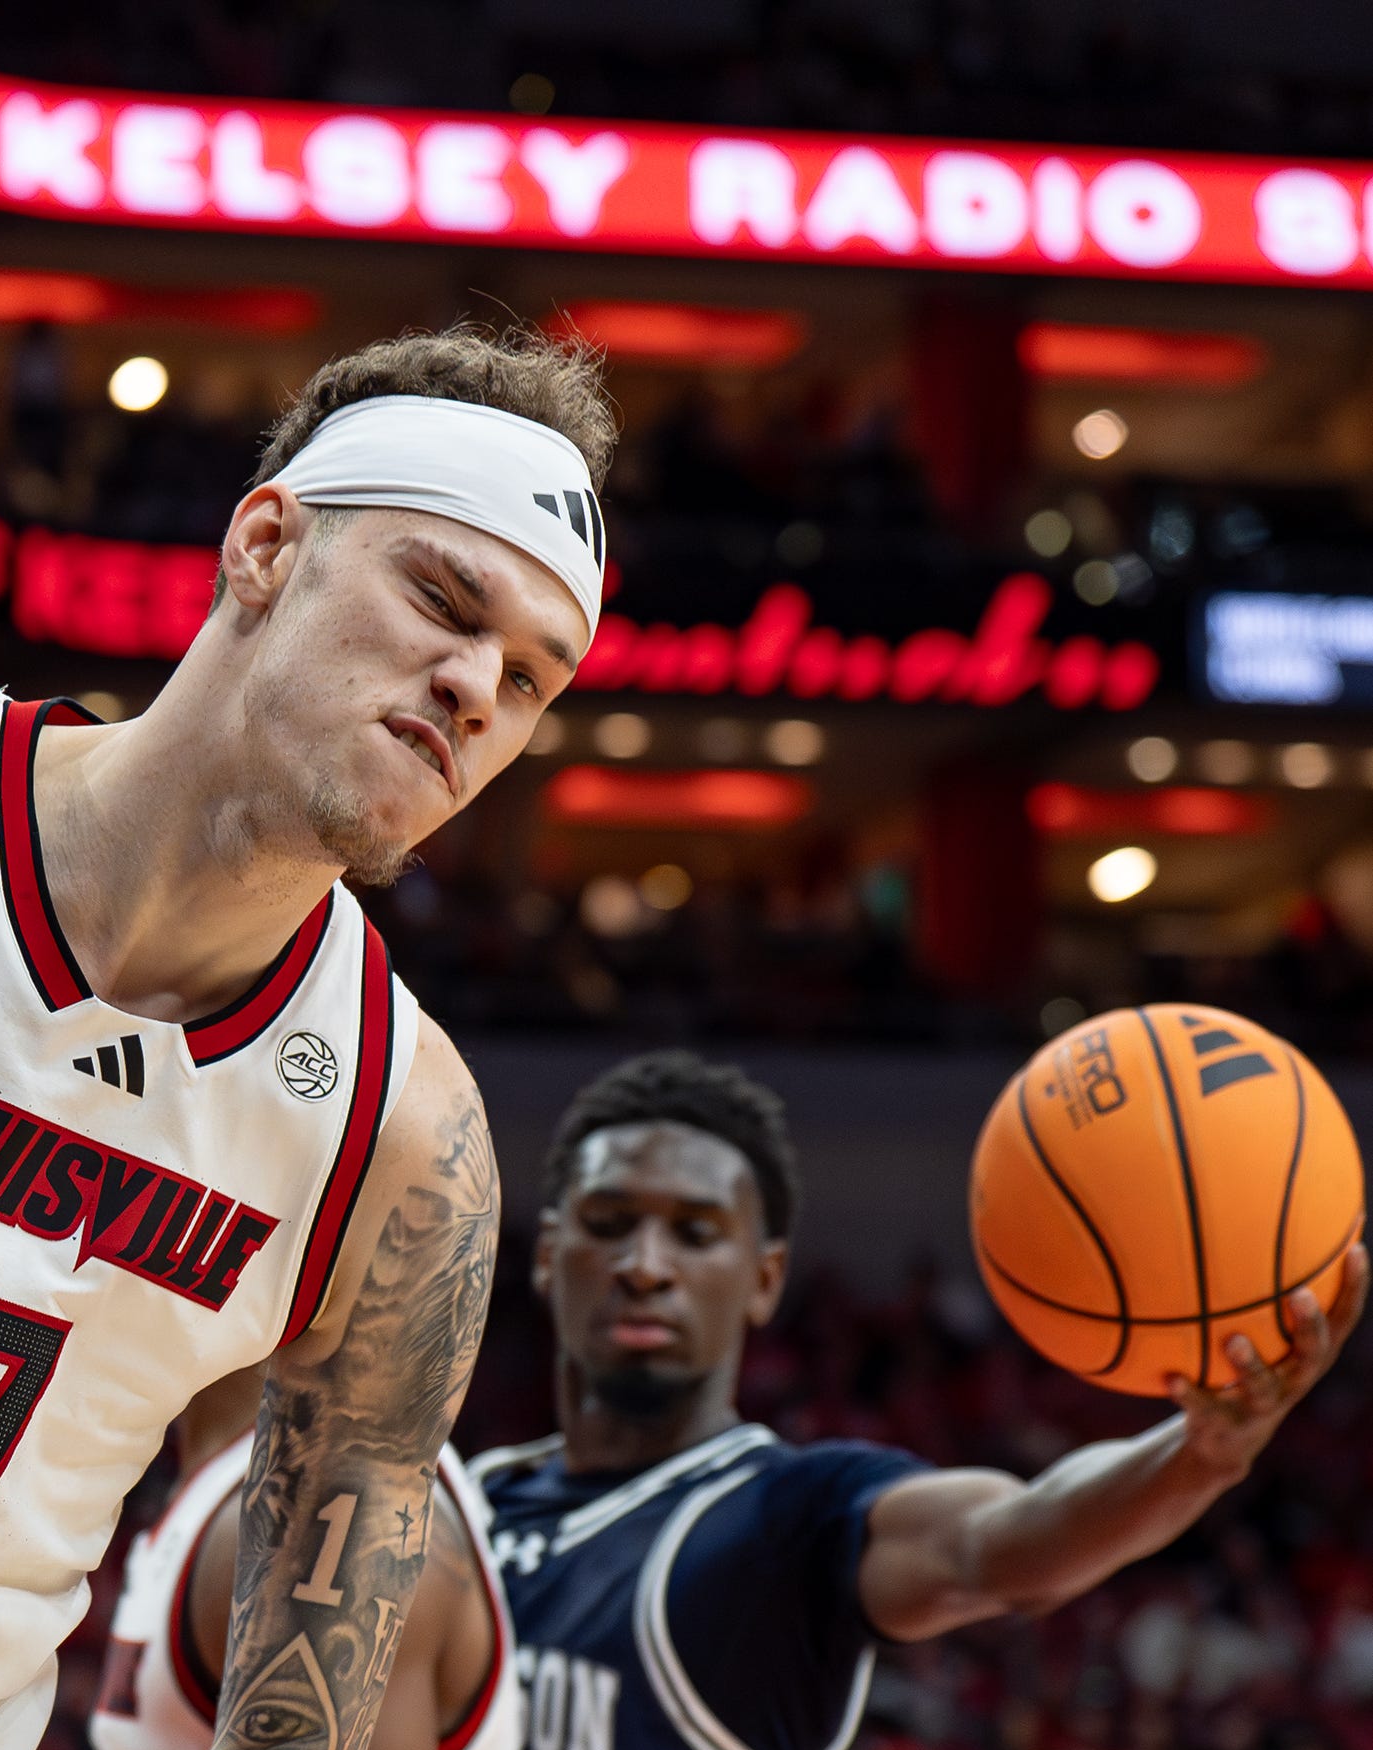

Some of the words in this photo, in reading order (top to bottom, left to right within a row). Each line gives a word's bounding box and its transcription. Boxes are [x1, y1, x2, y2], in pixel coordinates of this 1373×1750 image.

[688, 137, 1202, 268] RADIO
[1252, 168, 1373, 277] S
[285, 1052, 337, 1080] ACC
